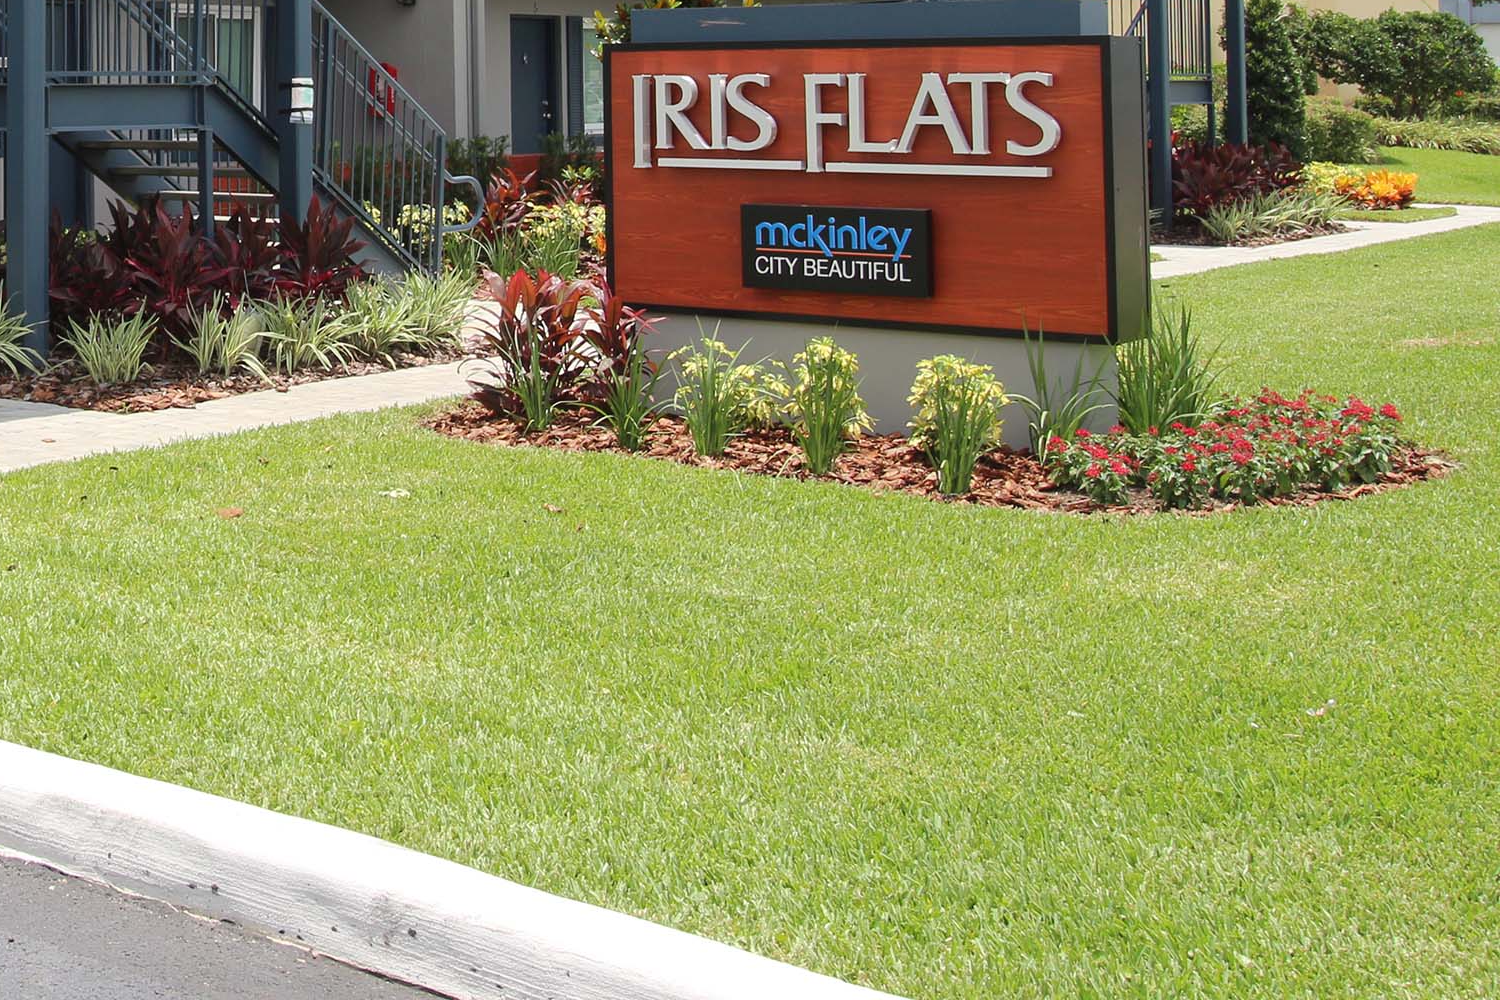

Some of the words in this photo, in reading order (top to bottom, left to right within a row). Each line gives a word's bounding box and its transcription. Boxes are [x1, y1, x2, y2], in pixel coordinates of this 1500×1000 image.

[632, 73, 777, 168] IRIS
[803, 72, 1061, 173] FLATS
[756, 214, 912, 262] mckinley
[755, 255, 798, 276] CITY
[803, 258, 911, 282] BEAUTIFUL
